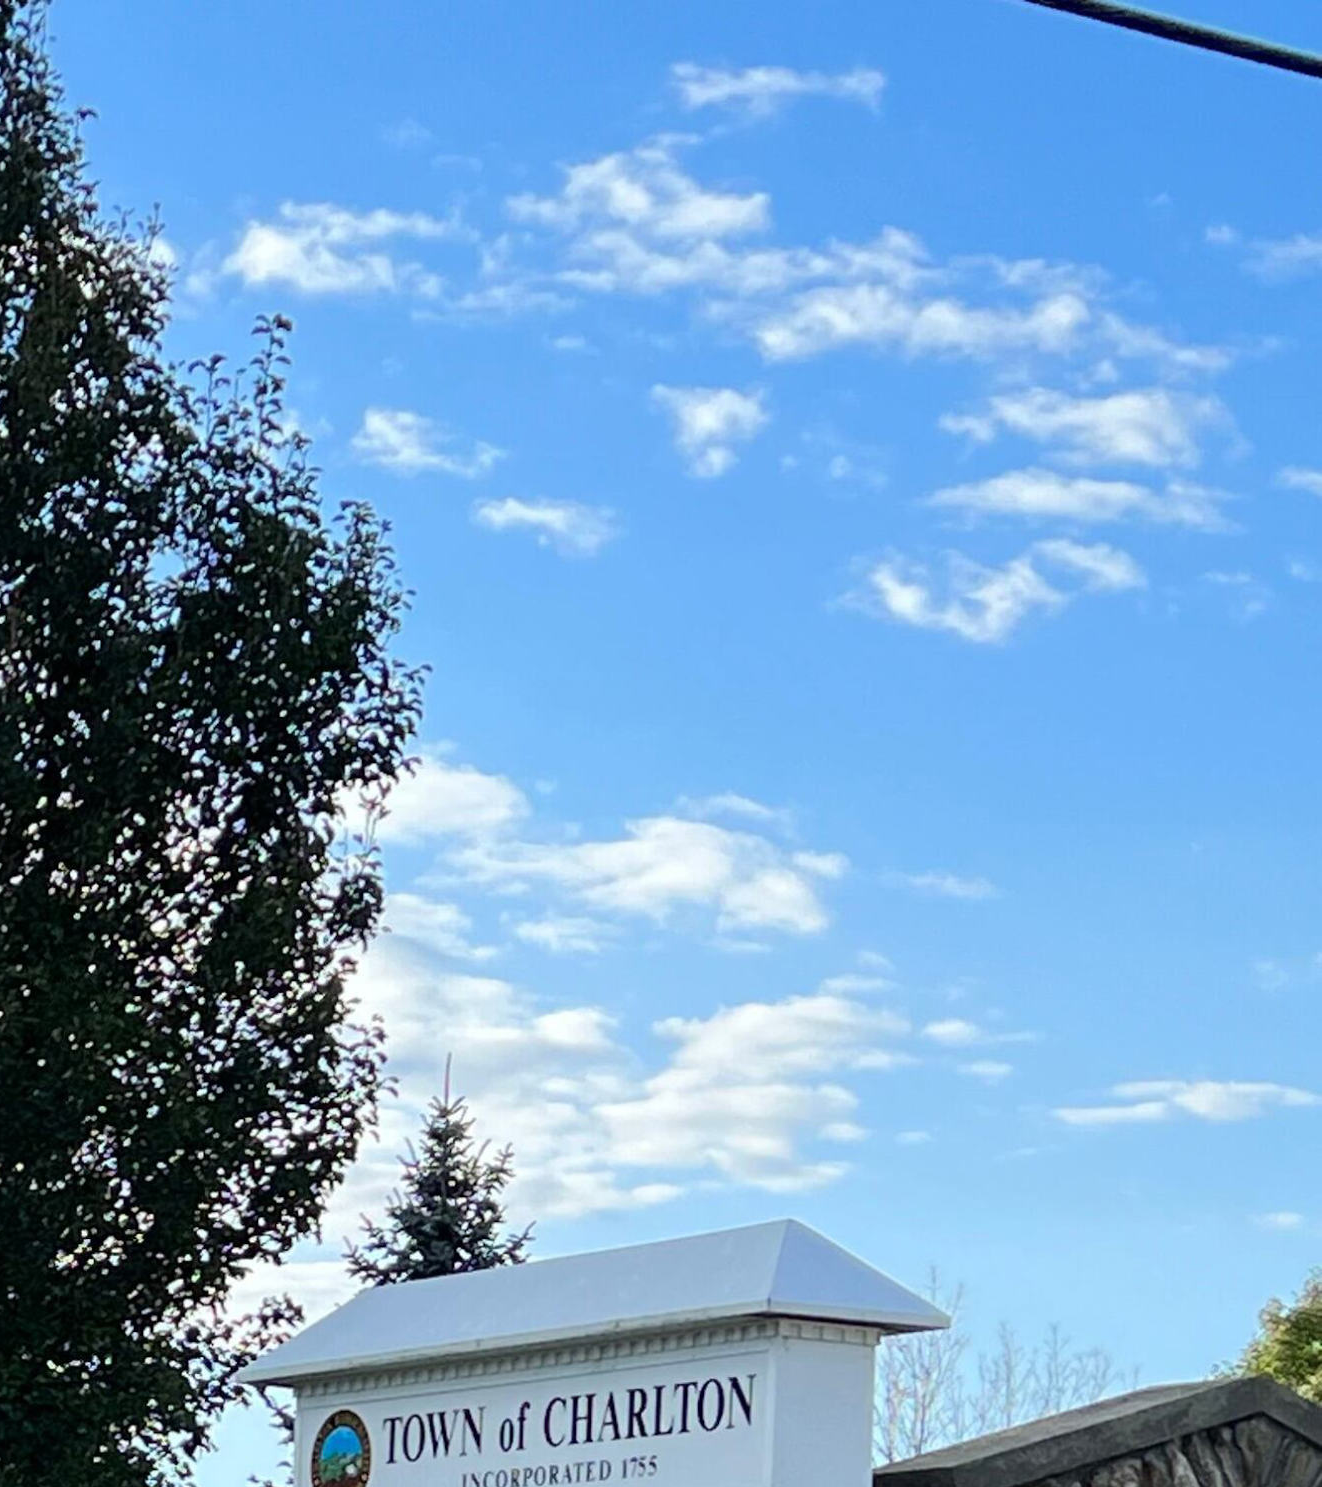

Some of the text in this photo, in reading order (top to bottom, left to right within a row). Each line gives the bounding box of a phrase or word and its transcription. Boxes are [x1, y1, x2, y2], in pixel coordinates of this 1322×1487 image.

[382, 1406, 487, 1464] TOWN
[499, 1401, 530, 1452] of
[543, 1373, 757, 1448] CHARLTON
[621, 1455, 658, 1480] 1755
